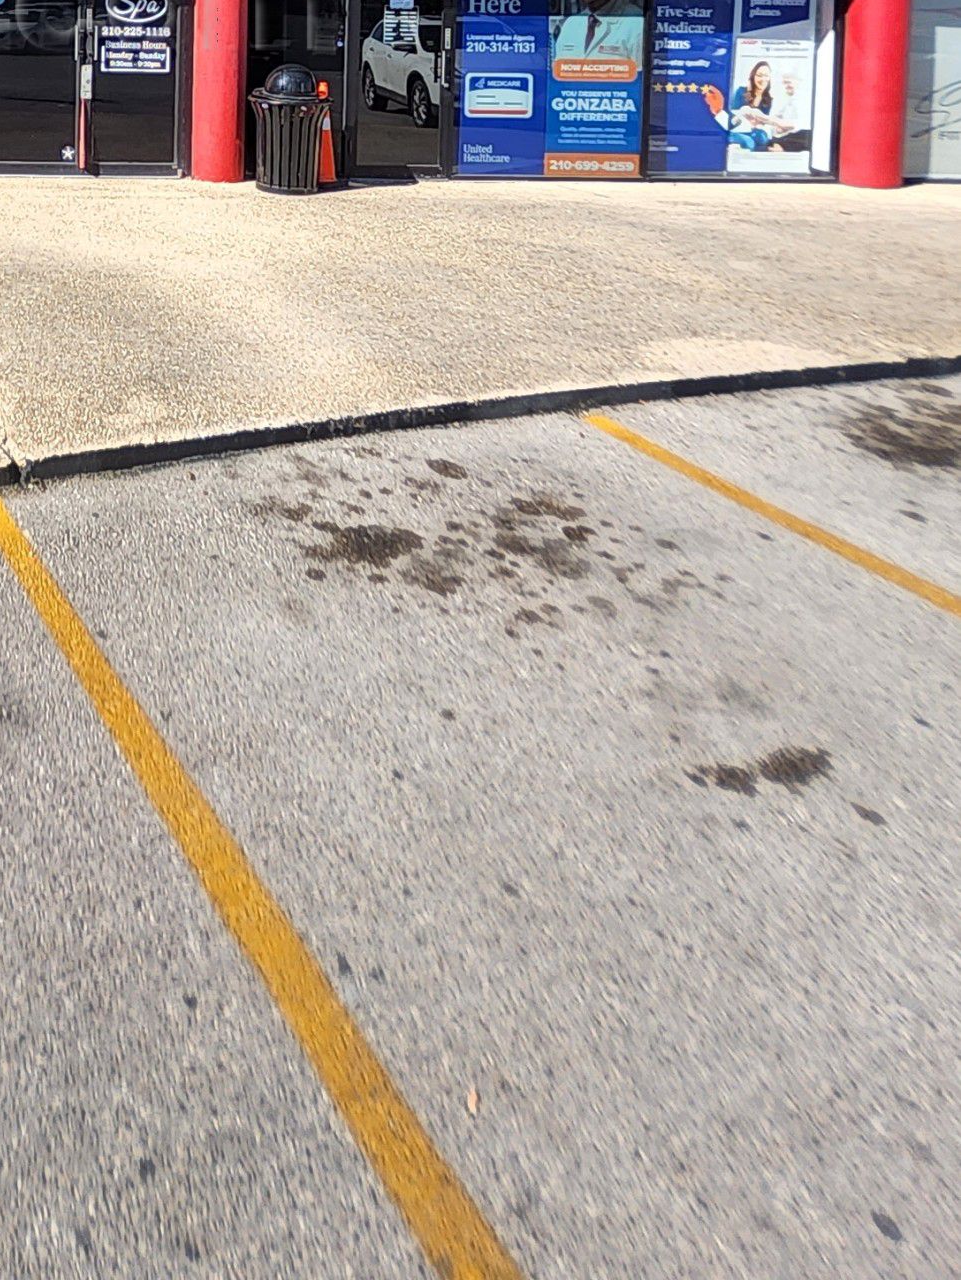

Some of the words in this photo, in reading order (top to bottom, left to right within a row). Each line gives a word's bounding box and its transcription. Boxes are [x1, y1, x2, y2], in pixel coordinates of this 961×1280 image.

[656, 6, 714, 19] Five-star
[655, 21, 716, 35] Medicare
[142, 40, 168, 49] Hours
[466, 42, 536, 53] 210-314-1131
[654, 38, 691, 51] plans
[551, 97, 637, 112] GONZABA
[463, 144, 493, 153] United
[463, 154, 511, 163] Healthcare
